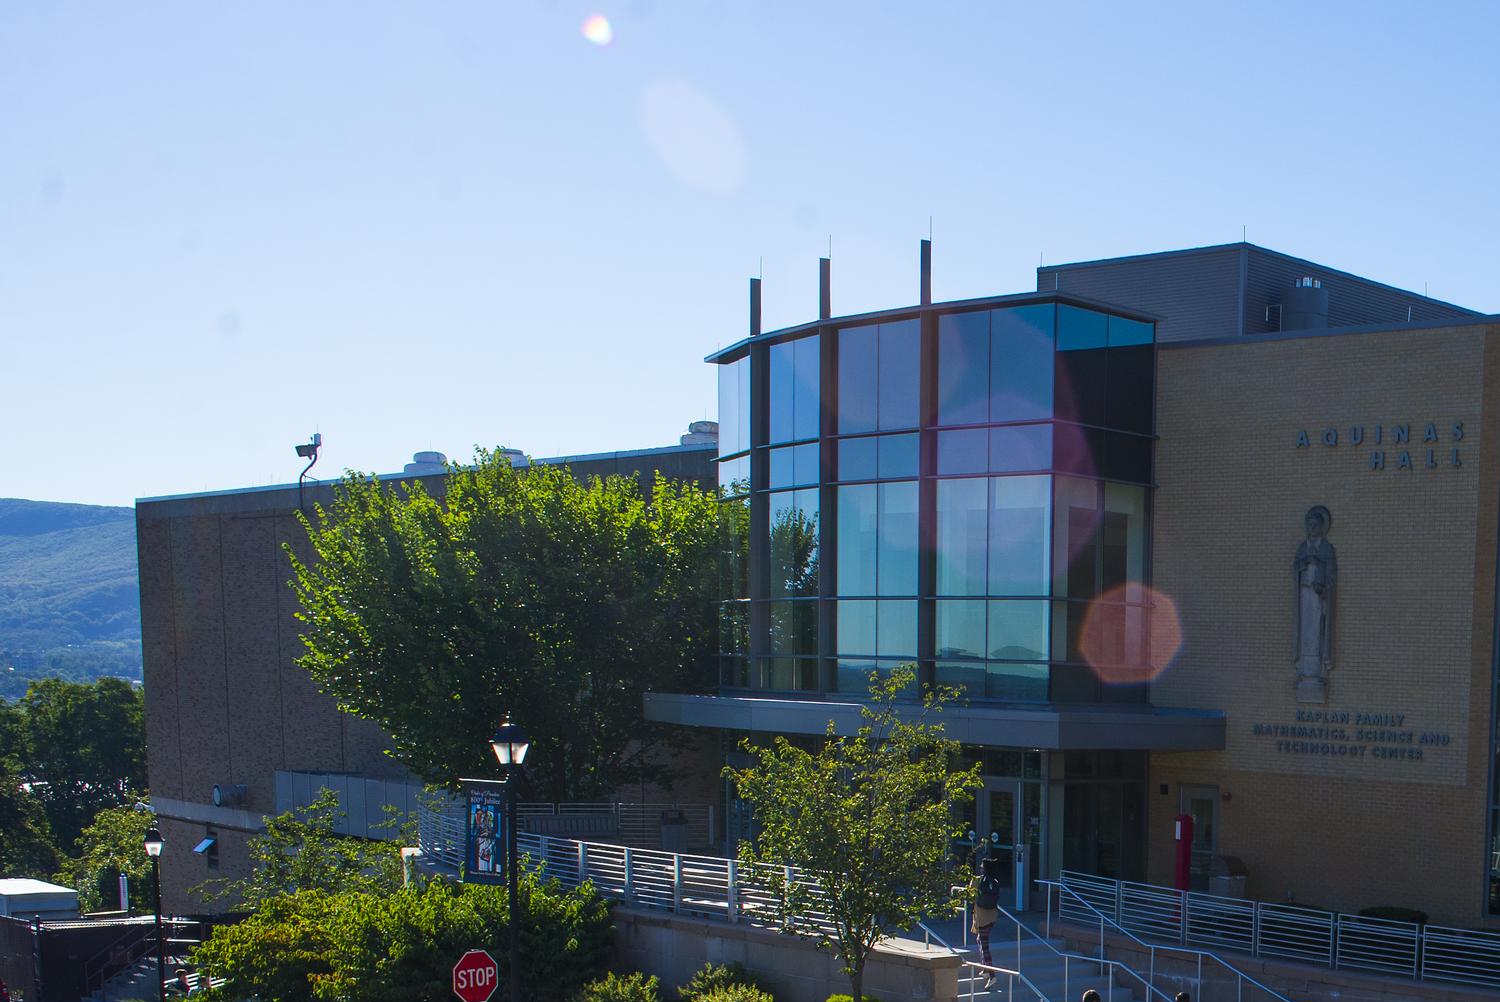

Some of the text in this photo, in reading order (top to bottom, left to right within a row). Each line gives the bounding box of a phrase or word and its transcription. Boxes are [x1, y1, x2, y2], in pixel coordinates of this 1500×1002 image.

[1296, 422, 1465, 448] AQUINAS
[1371, 449, 1463, 471] HALL
[1296, 711, 1405, 728] KAPLAN FAMILY
[1253, 723, 1450, 746] MATHEMATICS, SCIENCE AND
[1276, 740, 1423, 760] TECHNOLOGY CENTER
[457, 966, 495, 989] STOP
